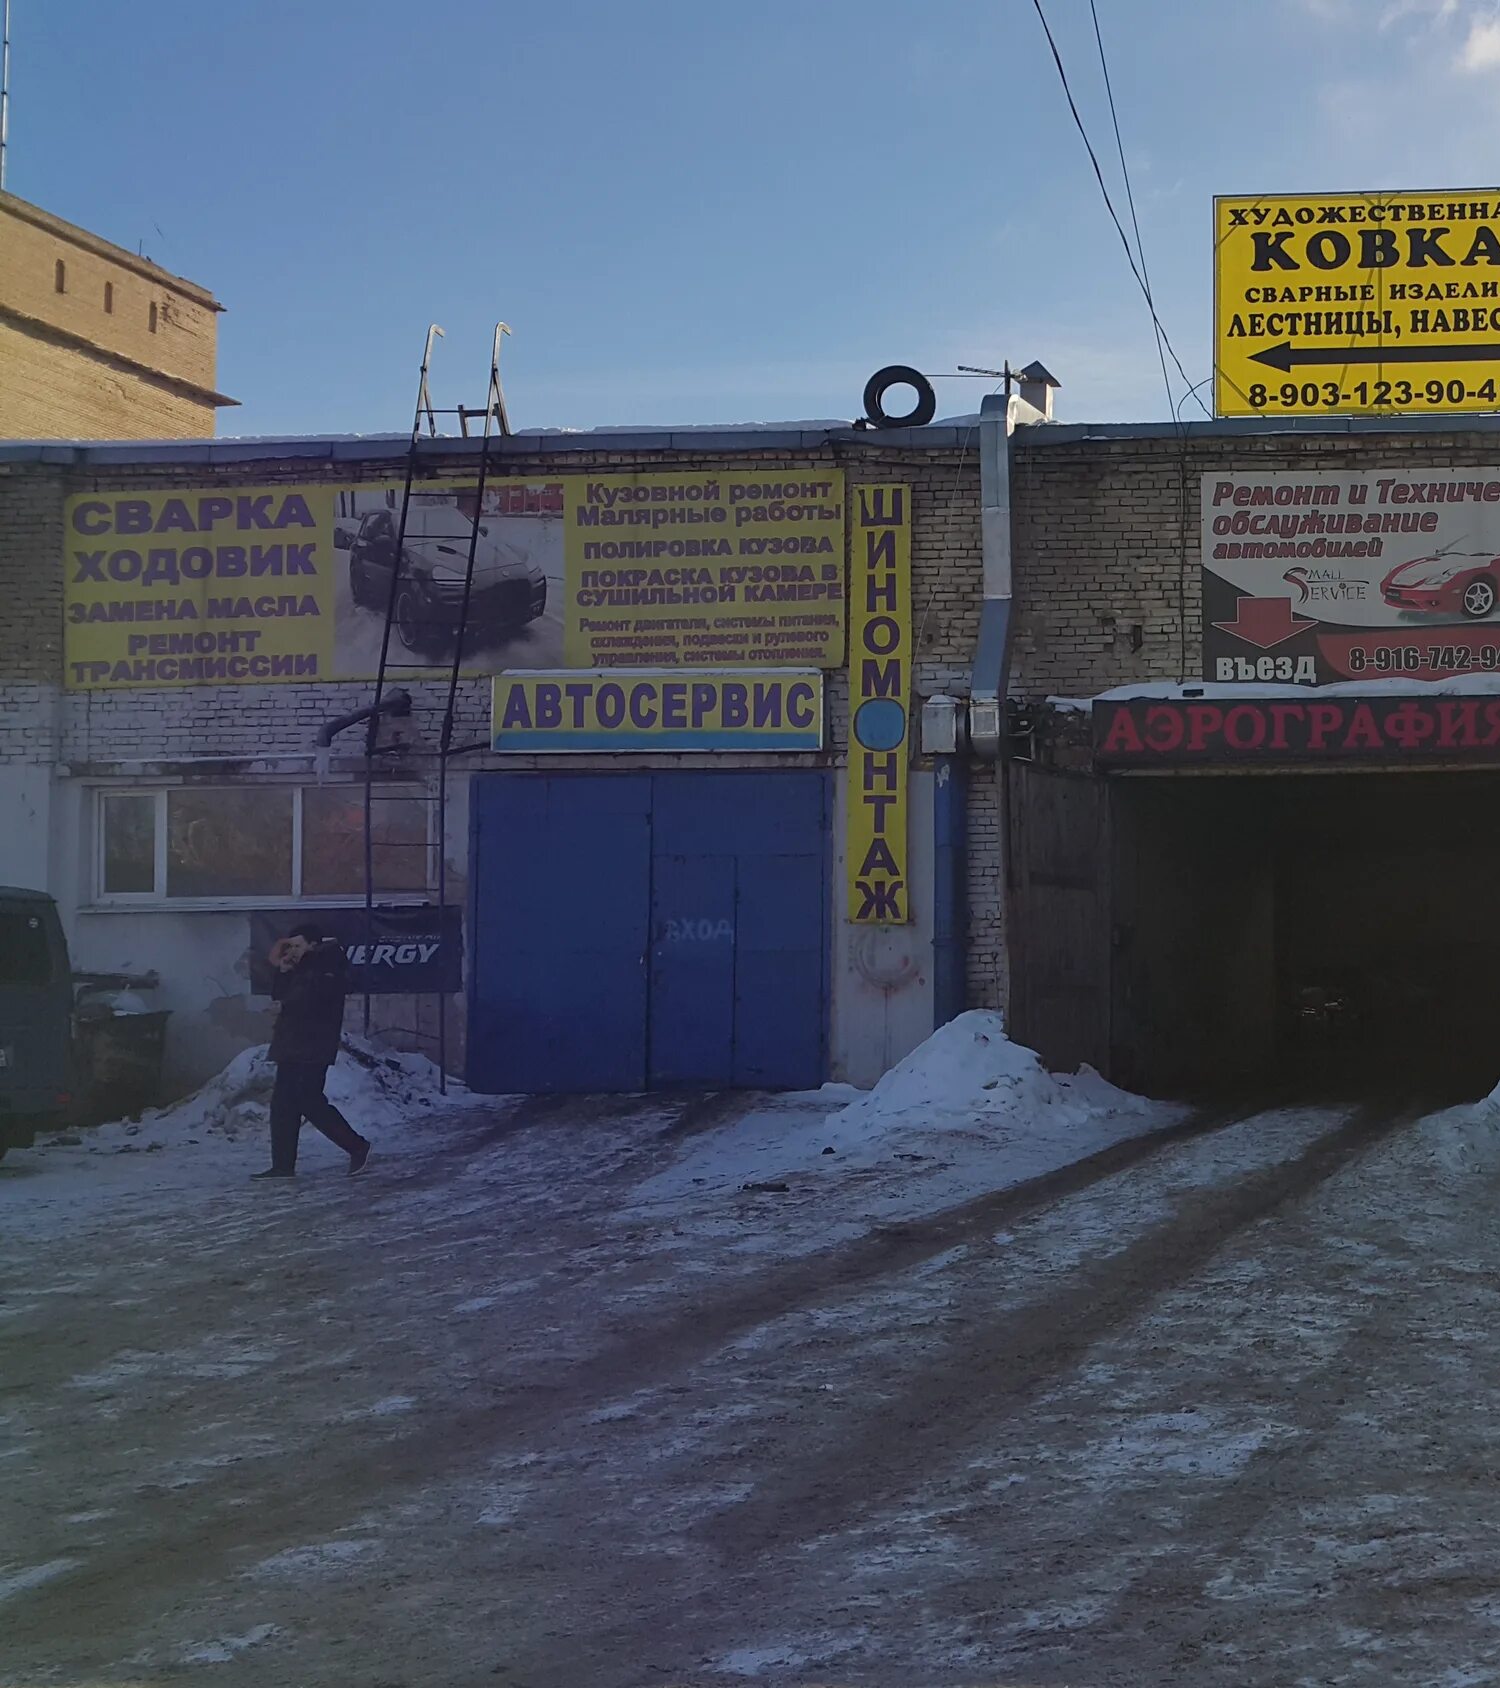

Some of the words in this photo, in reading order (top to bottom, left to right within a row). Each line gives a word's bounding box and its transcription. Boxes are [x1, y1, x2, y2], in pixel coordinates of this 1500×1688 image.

[1245, 284, 1375, 303] СВАРНЫЕ
[1227, 310, 1401, 339] ЛЕСТНИЦЫ,
[586, 480, 720, 508] Кузовной
[728, 482, 833, 505] ремонт
[1212, 481, 1340, 507] Ремонт
[1348, 483, 1370, 505] и
[72, 494, 316, 536] СВАРКА
[576, 506, 727, 529] Малярные
[735, 500, 842, 527] работы
[1212, 510, 1439, 538] обслуживание
[583, 538, 733, 560] ПОЛИРОВКА
[738, 536, 834, 555] КУЗОВА
[1212, 537, 1384, 560] автомобилей
[71, 543, 317, 586] ХОДОВИК
[581, 567, 714, 588] ПОКРАСКА
[719, 565, 815, 584] КУЗОВА
[821, 564, 838, 581] В
[576, 583, 736, 607] СУШИЛЬНОЙ
[744, 583, 842, 602] КАМЕРЕ
[68, 600, 198, 624] ЗАМЕНА
[206, 595, 320, 619] МАСЛА
[128, 630, 261, 656] РЕМОНТ
[70, 654, 318, 683] ТРАНСМИССИИ
[502, 683, 815, 729] АВТОСЕРВИС
